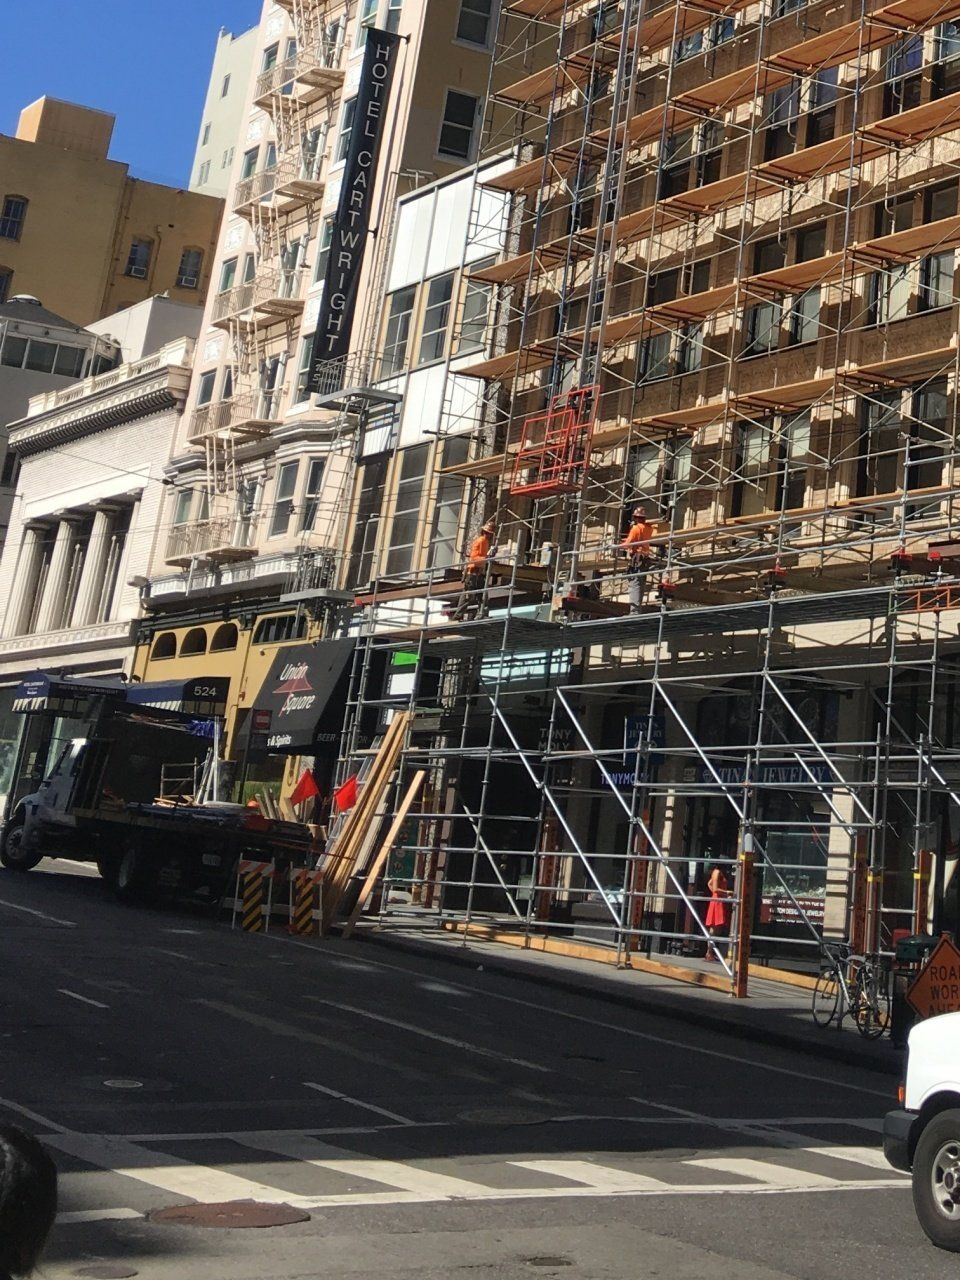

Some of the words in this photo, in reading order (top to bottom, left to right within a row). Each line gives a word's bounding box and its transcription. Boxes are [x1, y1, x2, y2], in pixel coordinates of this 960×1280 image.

[364, 44, 390, 137] HOTEL
[325, 151, 373, 352] CARTWRIGHT
[280, 662, 309, 680] Union
[193, 686, 217, 697] 524
[281, 693, 316, 715] Square
